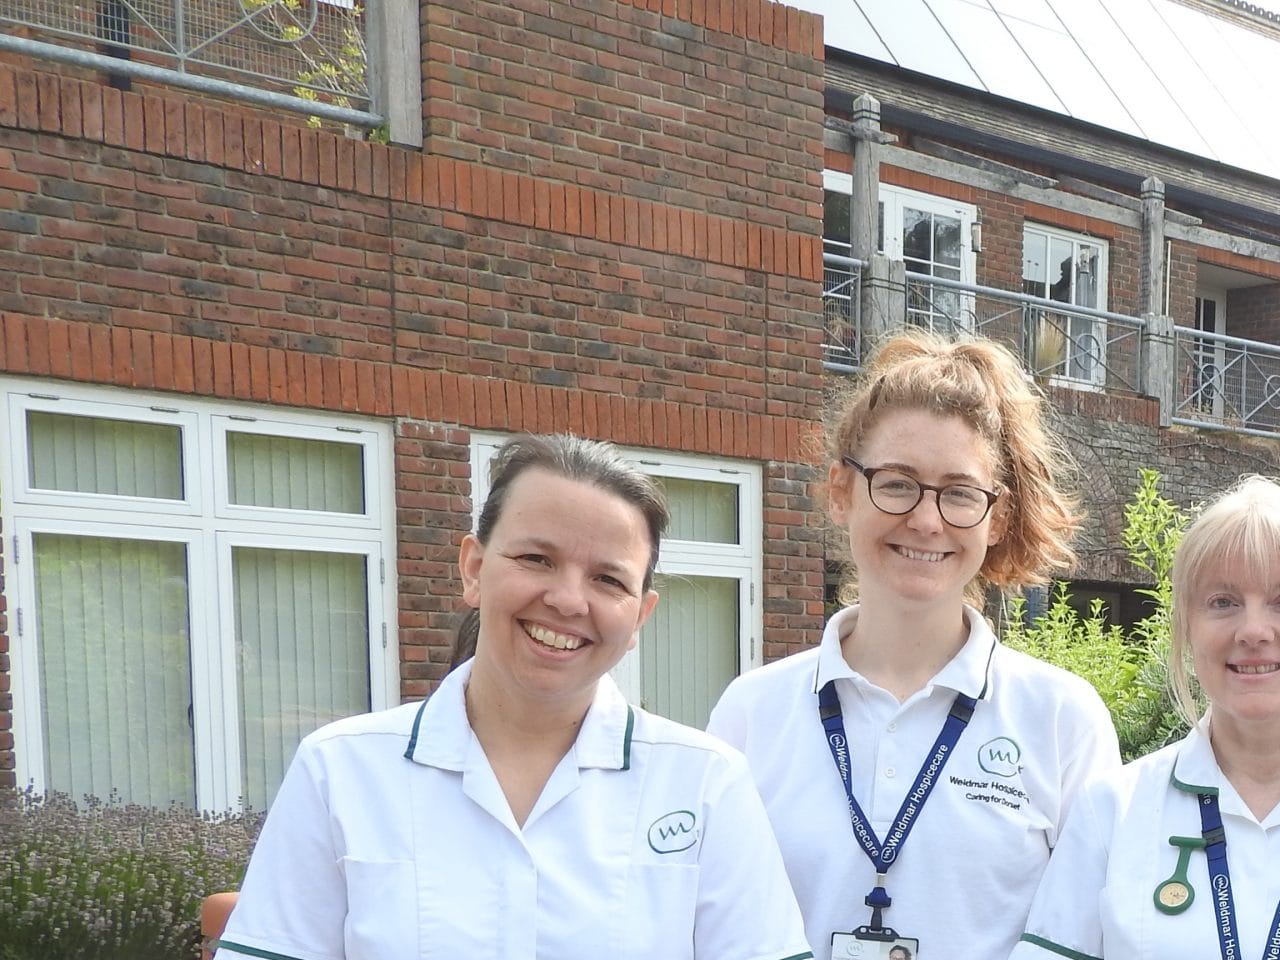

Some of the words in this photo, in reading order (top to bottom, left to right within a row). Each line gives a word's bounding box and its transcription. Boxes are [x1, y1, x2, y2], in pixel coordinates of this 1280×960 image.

[836, 746, 849, 783] Weldm
[886, 801, 917, 849] Weldmar
[911, 744, 948, 803] Hospicecare
[949, 775, 989, 788] Weldmar
[991, 781, 1027, 799] Hospice
[965, 792, 990, 802] Caring
[991, 794, 1001, 803] for
[1217, 889, 1231, 937] Weldmar
